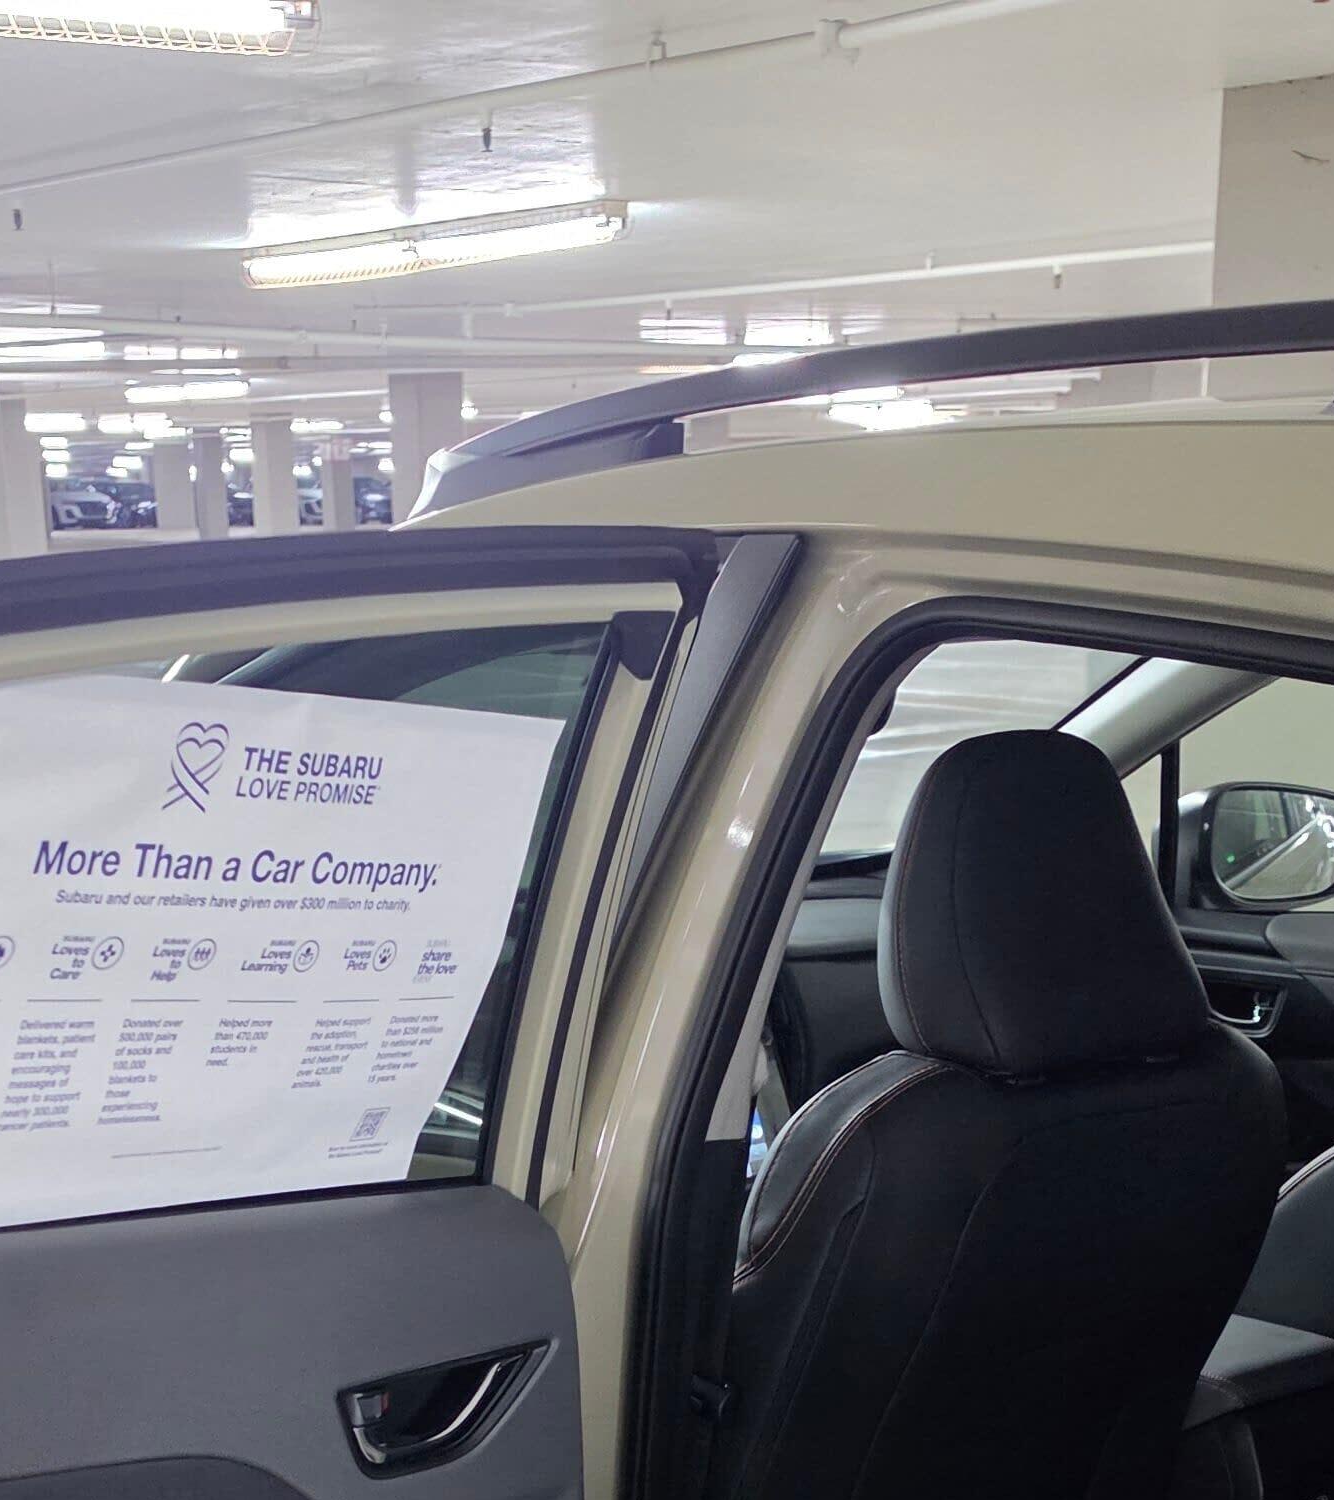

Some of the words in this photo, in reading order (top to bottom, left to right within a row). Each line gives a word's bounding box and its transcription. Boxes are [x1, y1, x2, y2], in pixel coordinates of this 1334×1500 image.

[243, 746, 292, 775] THE
[296, 752, 384, 779] SUBARU
[236, 776, 291, 801] LOVE
[293, 782, 377, 806] PROMISE
[33, 840, 121, 877] More
[135, 843, 213, 881] Than
[222, 856, 241, 882] a
[251, 849, 305, 884] Car
[311, 851, 438, 893] Company.
[56, 889, 102, 905] Subaru
[106, 892, 132, 906] and
[133, 894, 156, 906] our
[157, 893, 206, 908] retailers
[209, 895, 237, 909] have
[239, 897, 271, 912] given
[273, 899, 298, 911] over
[326, 898, 363, 911] million
[364, 898, 375, 911] to
[376, 898, 411, 913] charity.
[52, 944, 90, 956] Loves
[153, 946, 186, 958] Loves
[261, 948, 292, 960] Loves
[344, 948, 372, 960] Loves
[422, 950, 452, 962] share
[72, 958, 84, 969] to
[170, 958, 181, 969] to
[241, 961, 288, 974] Learning
[346, 961, 369, 971] Pets
[418, 963, 434, 975] the
[435, 963, 458, 974] love
[50, 968, 81, 980] Care
[150, 970, 177, 982] Help
[20, 1019, 67, 1030] Delivered
[123, 1019, 162, 1028] Donated
[163, 1020, 183, 1028] over
[219, 1018, 250, 1029] Helped
[251, 1020, 273, 1028] more
[214, 1032, 233, 1041] than
[211, 1045, 246, 1054] students
